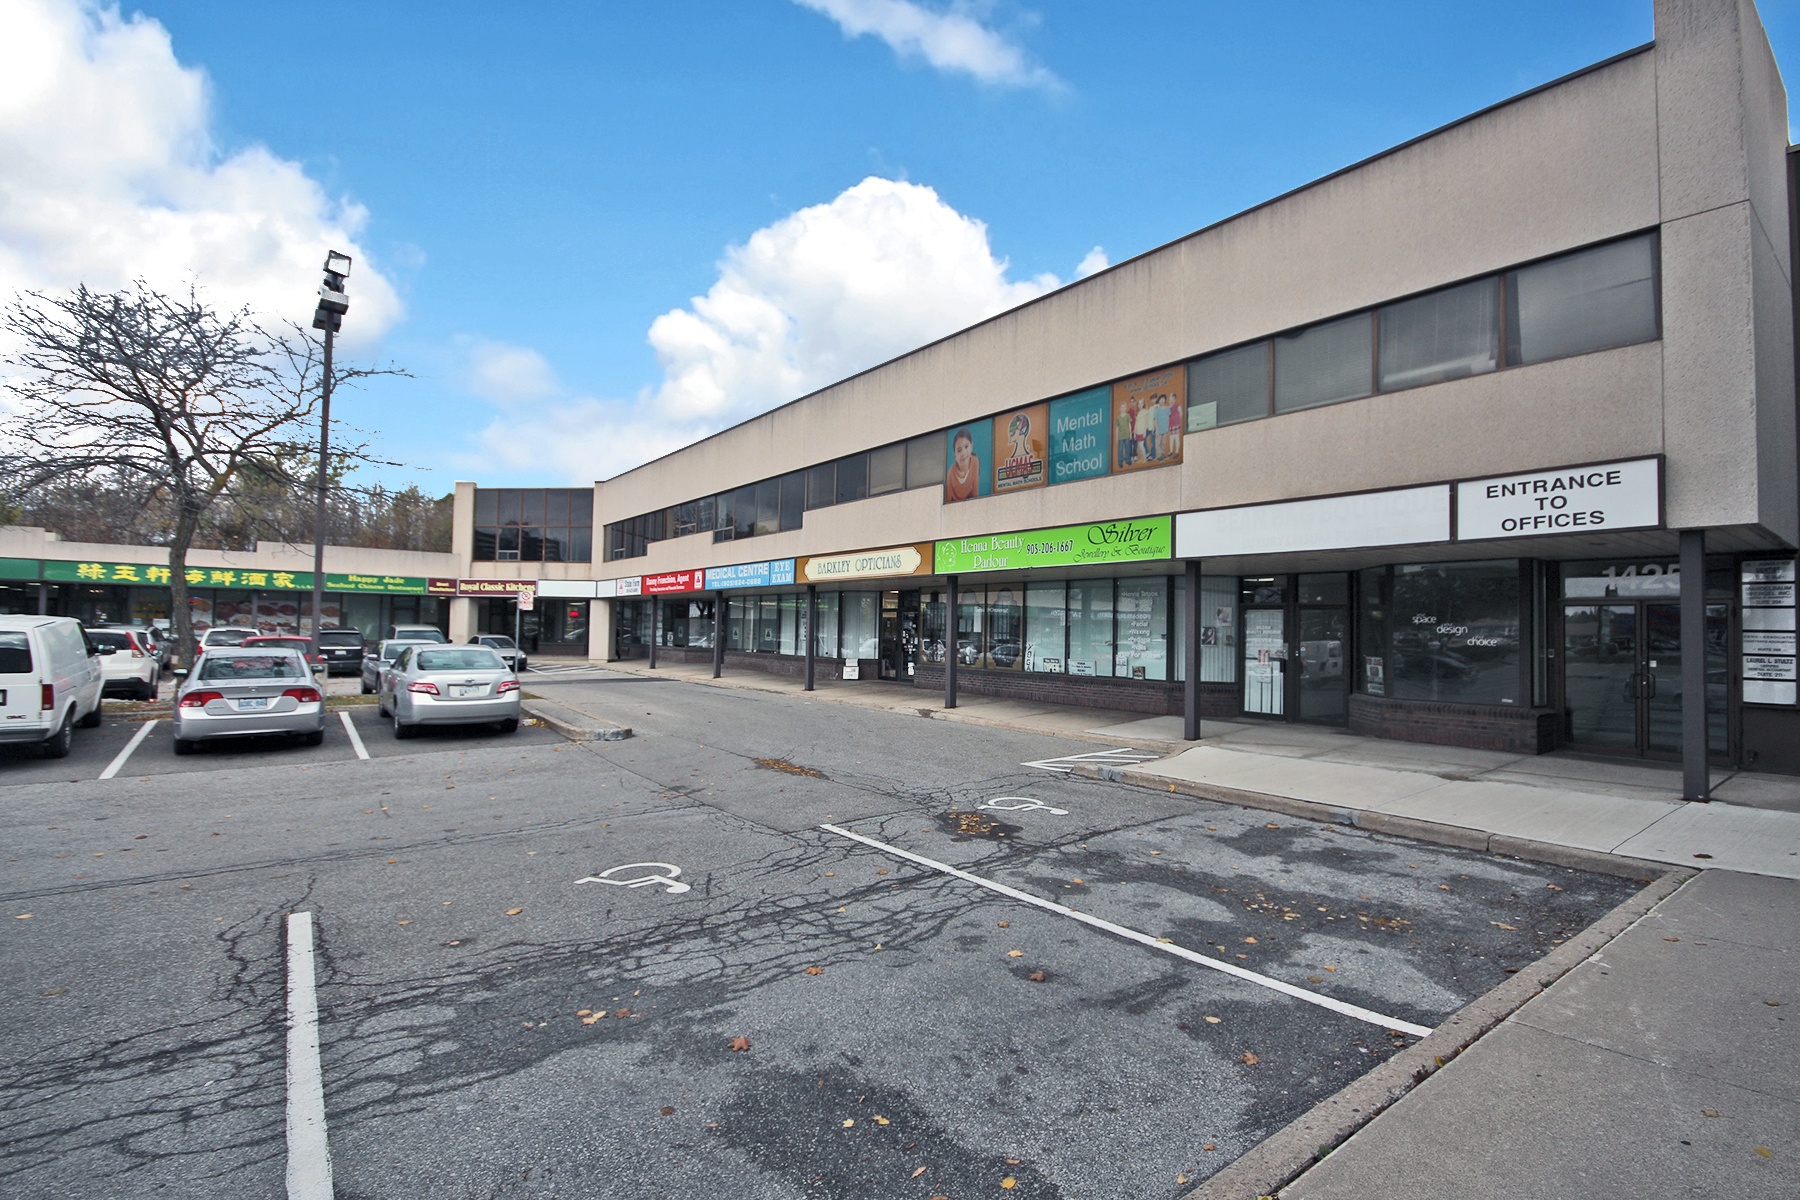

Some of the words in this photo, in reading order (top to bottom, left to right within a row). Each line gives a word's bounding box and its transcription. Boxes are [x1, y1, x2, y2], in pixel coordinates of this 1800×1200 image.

[1057, 408, 1102, 433] Mental
[1062, 433, 1096, 453] Math
[1006, 454, 1034, 478] UCMAS
[1056, 453, 1102, 476] School
[1486, 470, 1622, 498] ENTRANCE
[1534, 496, 1568, 510] TO
[1501, 510, 1604, 532] OFFICES
[1088, 522, 1158, 545] Silver
[960, 540, 988, 554] Henna
[991, 536, 1024, 554] Beauty
[1026, 540, 1074, 554] 905-206-1667
[1111, 546, 1122, 556] &
[1125, 544, 1165, 558] Boutique
[774, 562, 790, 572] EYE
[818, 560, 850, 574] BARKLEY
[855, 554, 902, 572] OPTICIANS
[973, 554, 1008, 568] Parlour
[706, 566, 736, 580] MEDICAL
[738, 562, 769, 577] CENTRE
[772, 573, 792, 583] EXAM
[348, 574, 379, 584] Happy
[383, 576, 405, 584] Jade
[677, 574, 690, 584] Agent
[460, 583, 480, 592] Royal
[480, 583, 504, 592] Classic
[506, 583, 536, 592] Kitchens
[1412, 616, 1436, 624] space
[1436, 624, 1468, 636] design
[1467, 636, 1498, 646] choice
[1026, 643, 1034, 672] YOGA
